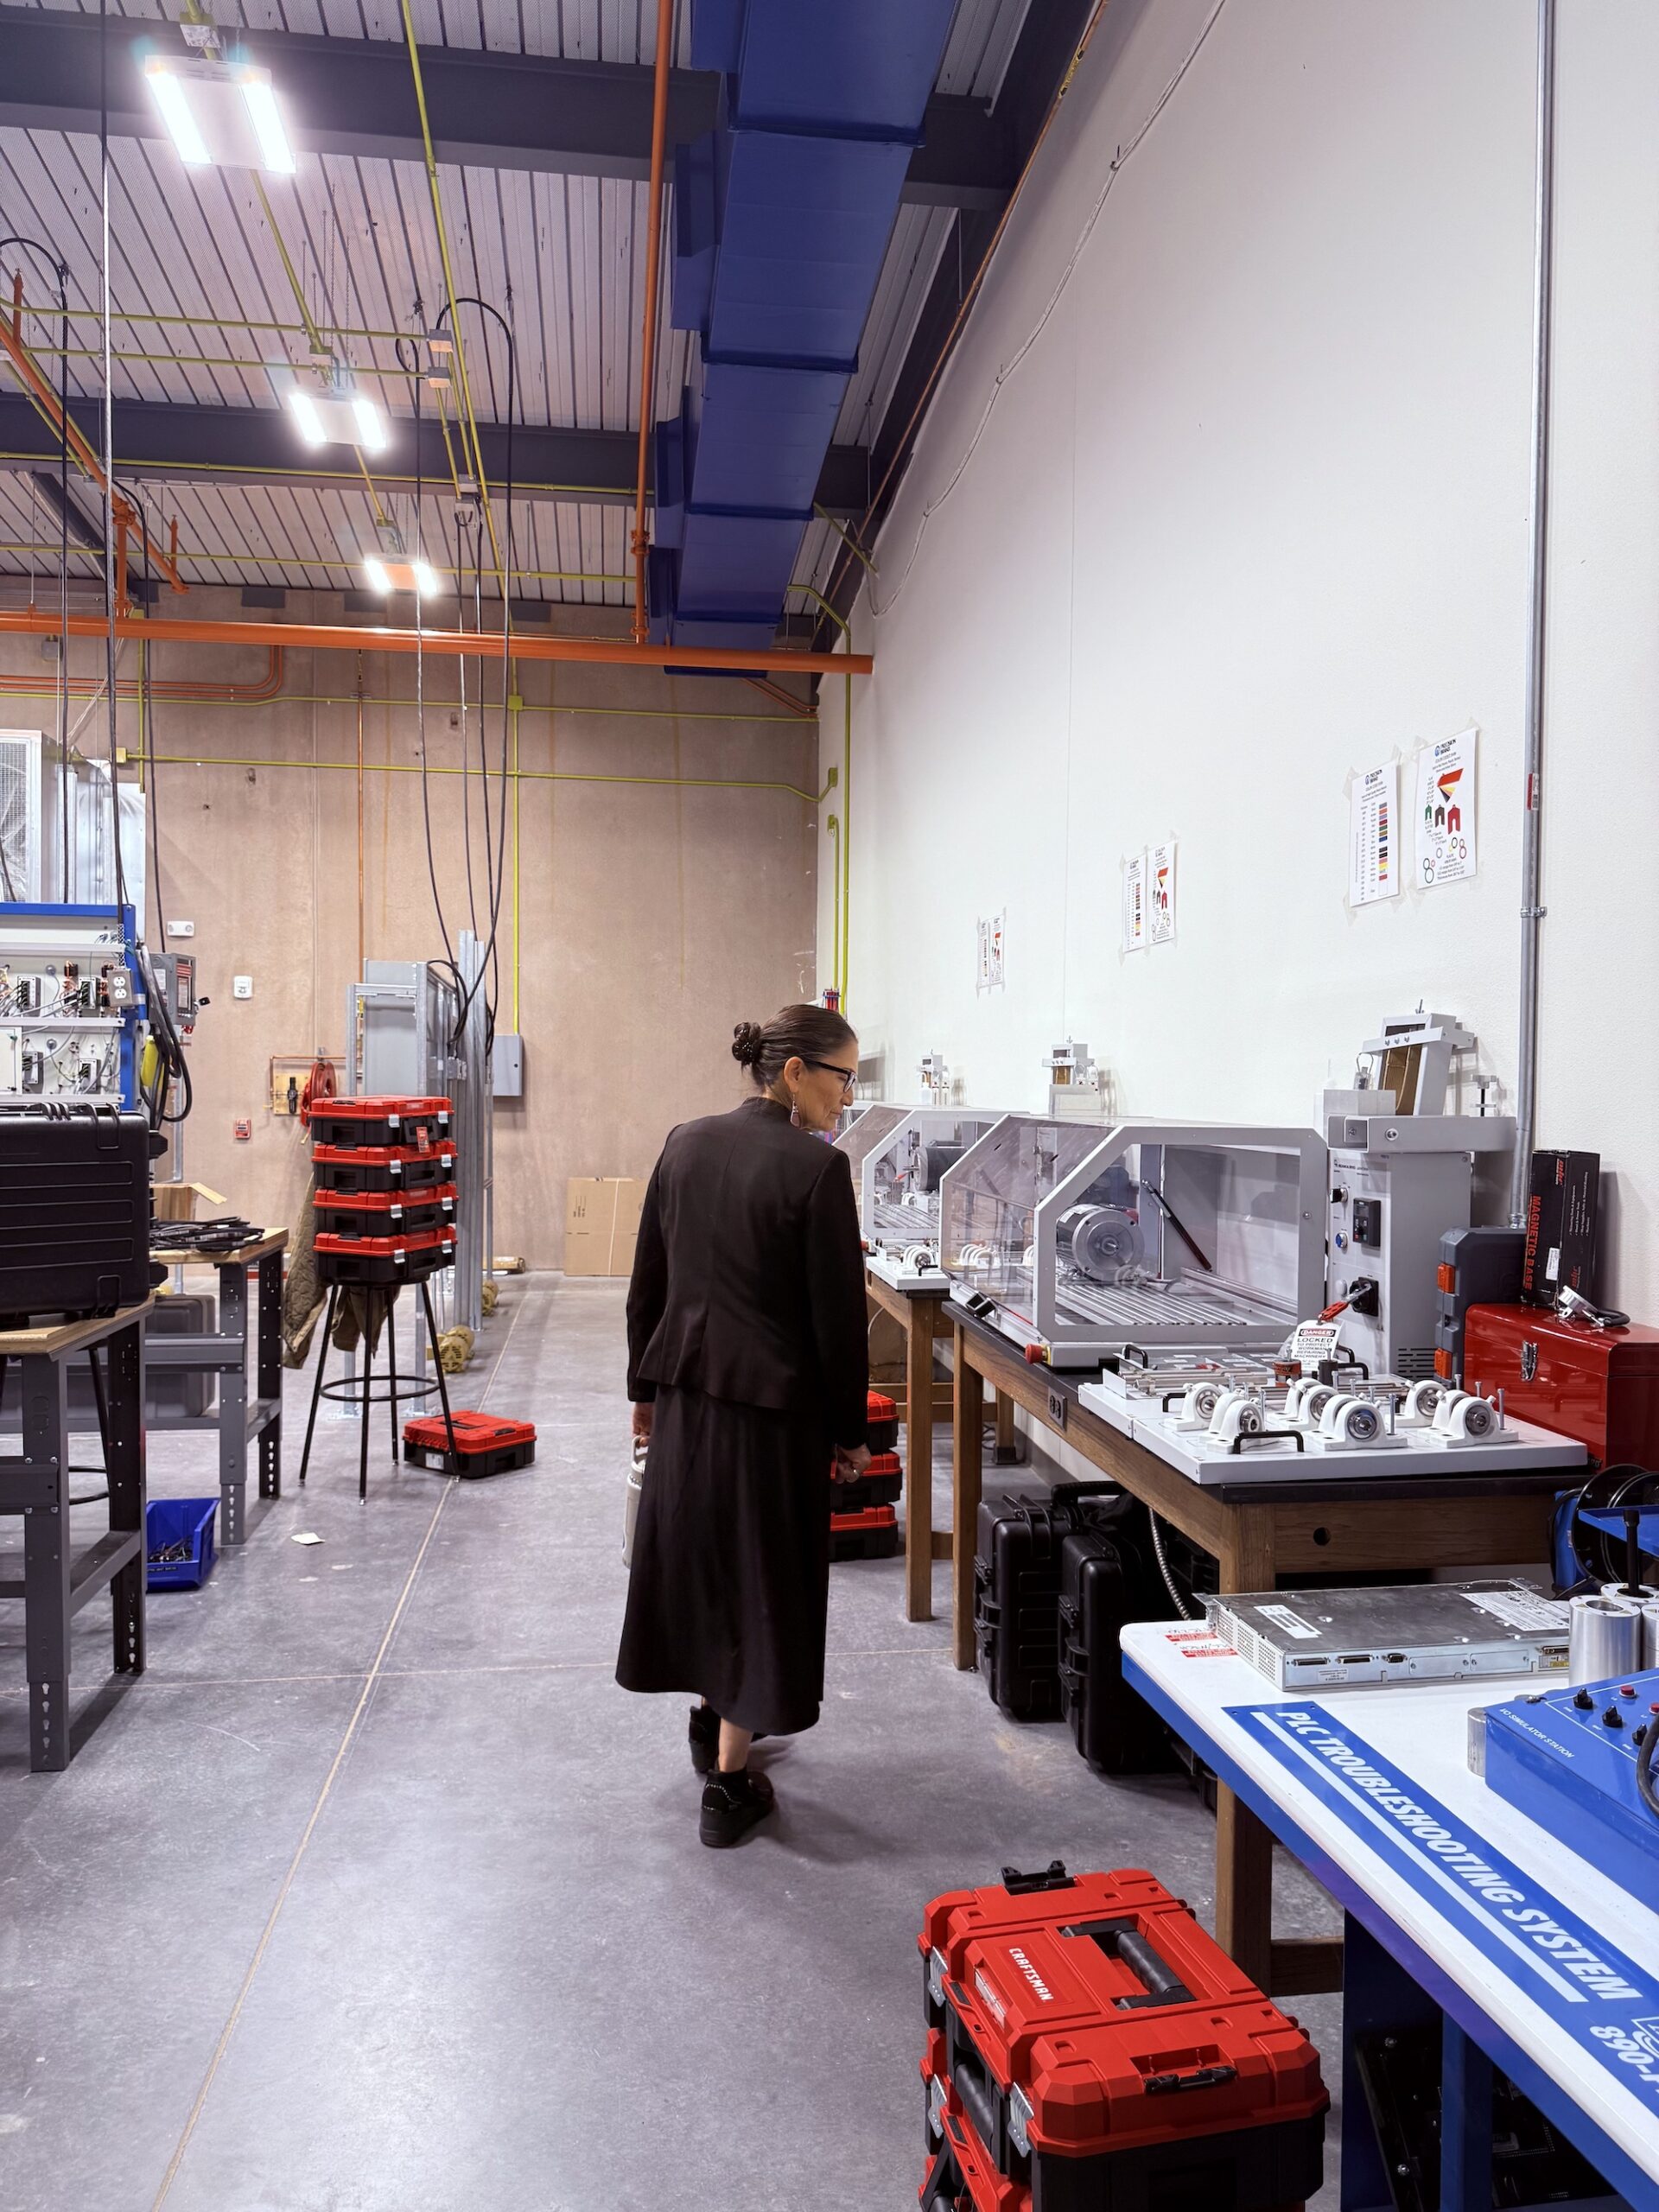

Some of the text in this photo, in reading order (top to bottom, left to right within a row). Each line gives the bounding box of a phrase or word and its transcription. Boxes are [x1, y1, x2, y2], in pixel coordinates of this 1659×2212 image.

[1524, 1195, 1541, 1290] MAGNETIC BASE
[1509, 1713, 1545, 1740] SIMULATOR
[1544, 1738, 1575, 1758] STATION
[1276, 1712, 1643, 2000] PLC TROUBLESHOOTING SYSTEM
[1008, 1948, 1054, 2001] CRAFTSMAN
